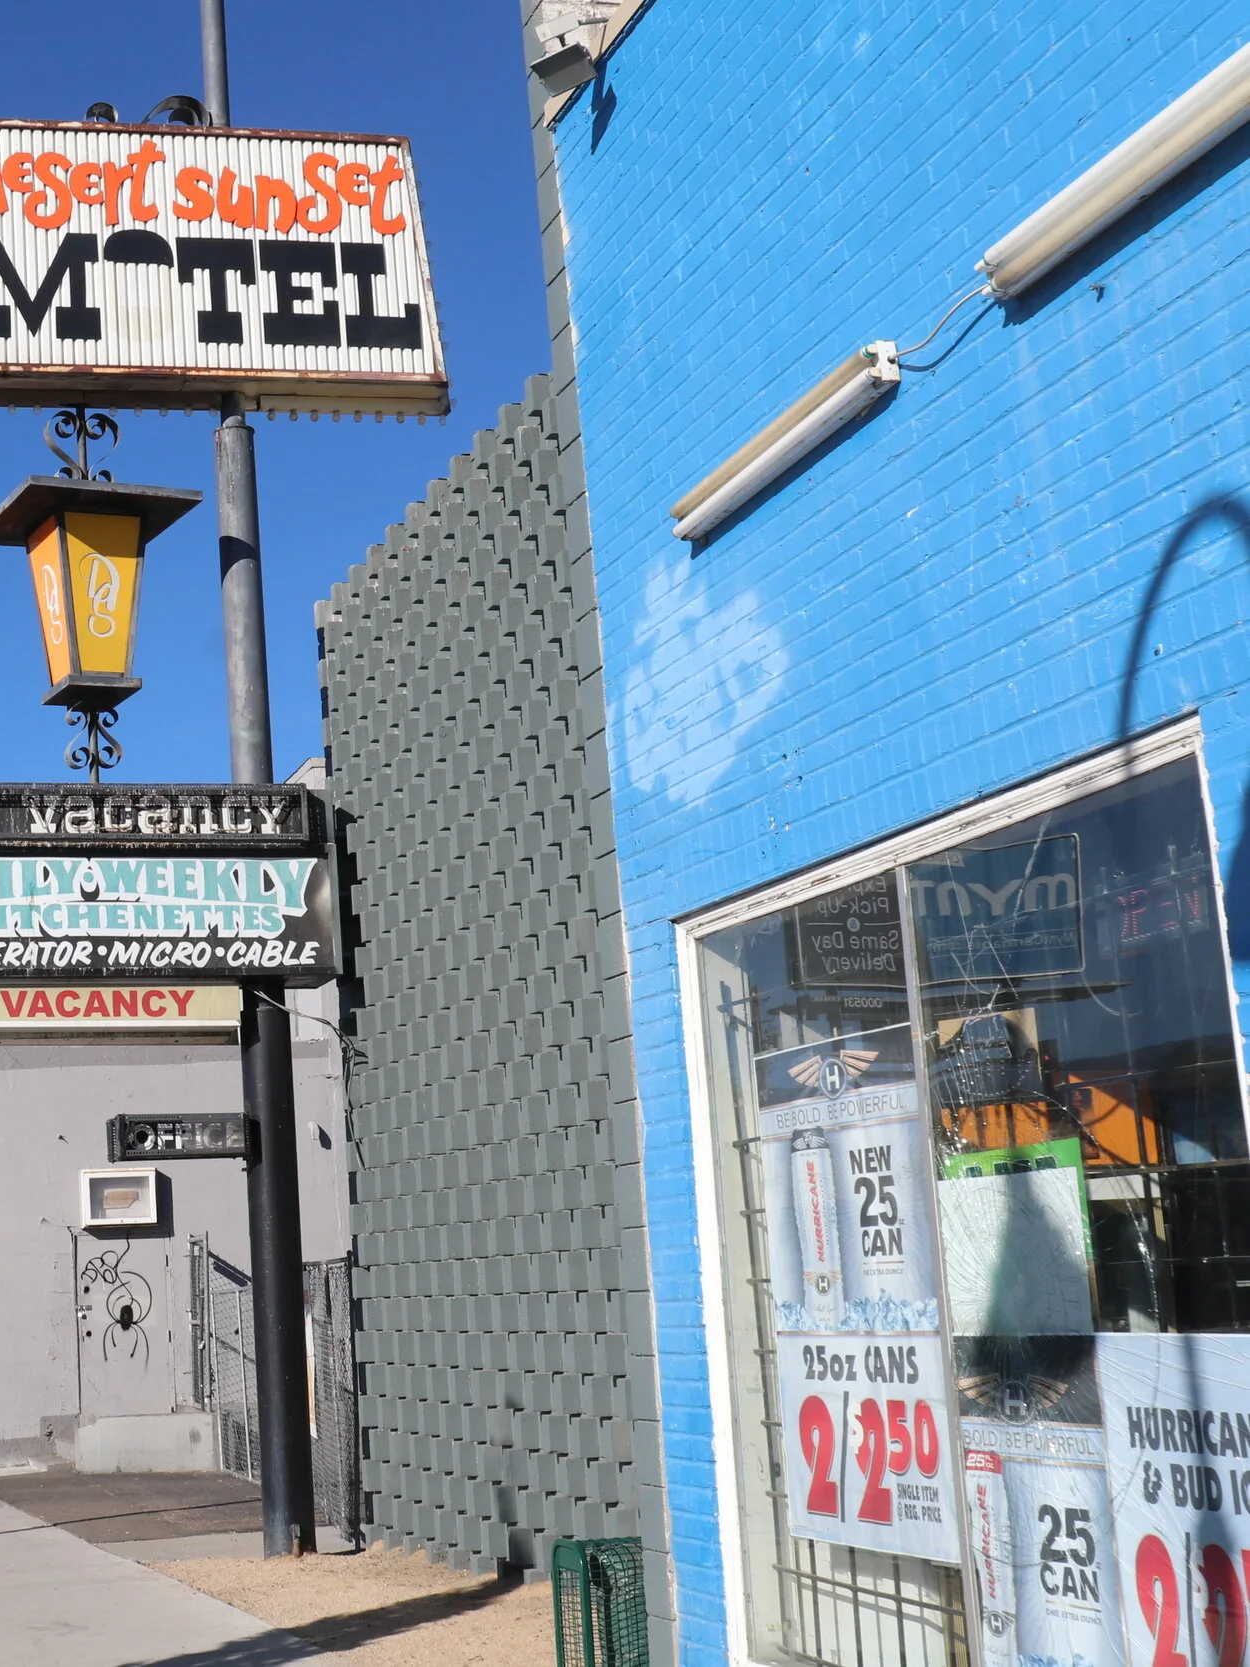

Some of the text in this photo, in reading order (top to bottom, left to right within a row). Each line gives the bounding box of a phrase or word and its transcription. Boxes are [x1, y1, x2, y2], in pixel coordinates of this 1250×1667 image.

[98, 857, 318, 917] WEEKLY
[108, 941, 212, 968] MICRO
[227, 941, 320, 966] CABLE
[0, 990, 195, 1018] VACANCY
[776, 1113, 791, 1129] BE
[827, 1103, 839, 1121] BE
[129, 1122, 246, 1151] OFFICE
[849, 1145, 892, 1175] NEW
[805, 1160, 826, 1263] HURRICANE
[854, 1175, 899, 1228] 25
[861, 1228, 904, 1258] CAN
[803, 1344, 920, 1385] 25oz CANS
[966, 1453, 985, 1467] 25
[896, 1482, 939, 1503] SINGLE ITEM
[1143, 1460, 1162, 1504] &
[1170, 1463, 1223, 1512] BUD
[922, 1504, 943, 1524] PRICE
[1038, 1504, 1096, 1568] 25
[1040, 1563, 1100, 1604] CAN
